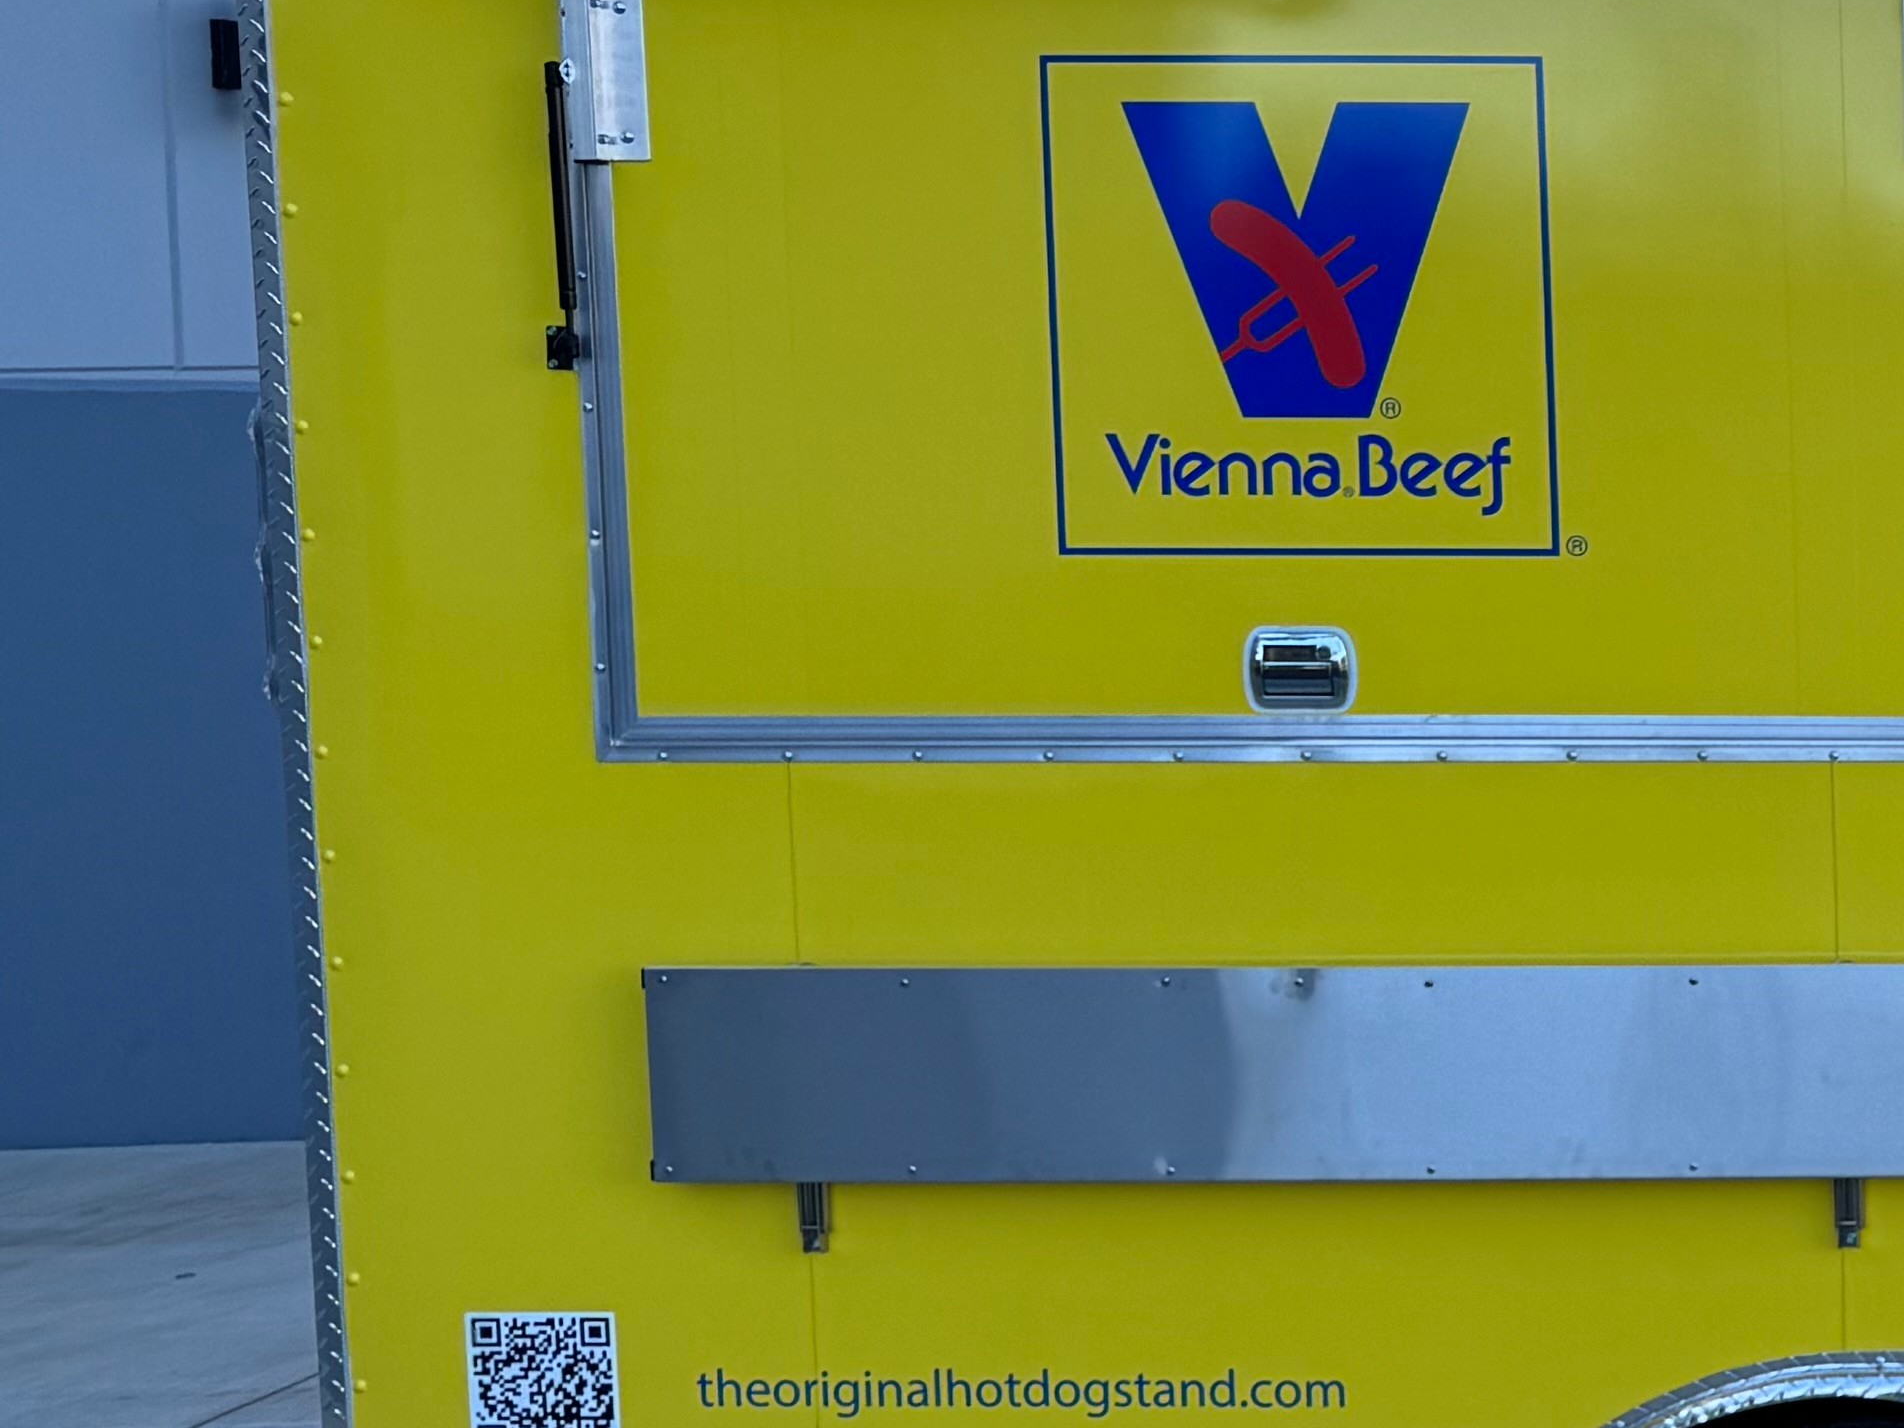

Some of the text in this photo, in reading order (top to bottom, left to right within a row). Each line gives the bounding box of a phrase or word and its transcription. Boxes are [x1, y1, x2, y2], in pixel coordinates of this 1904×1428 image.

[1105, 433, 1512, 516] Vienna Beef
[697, 1368, 1345, 1418] theoriginalhotdogstand.com
